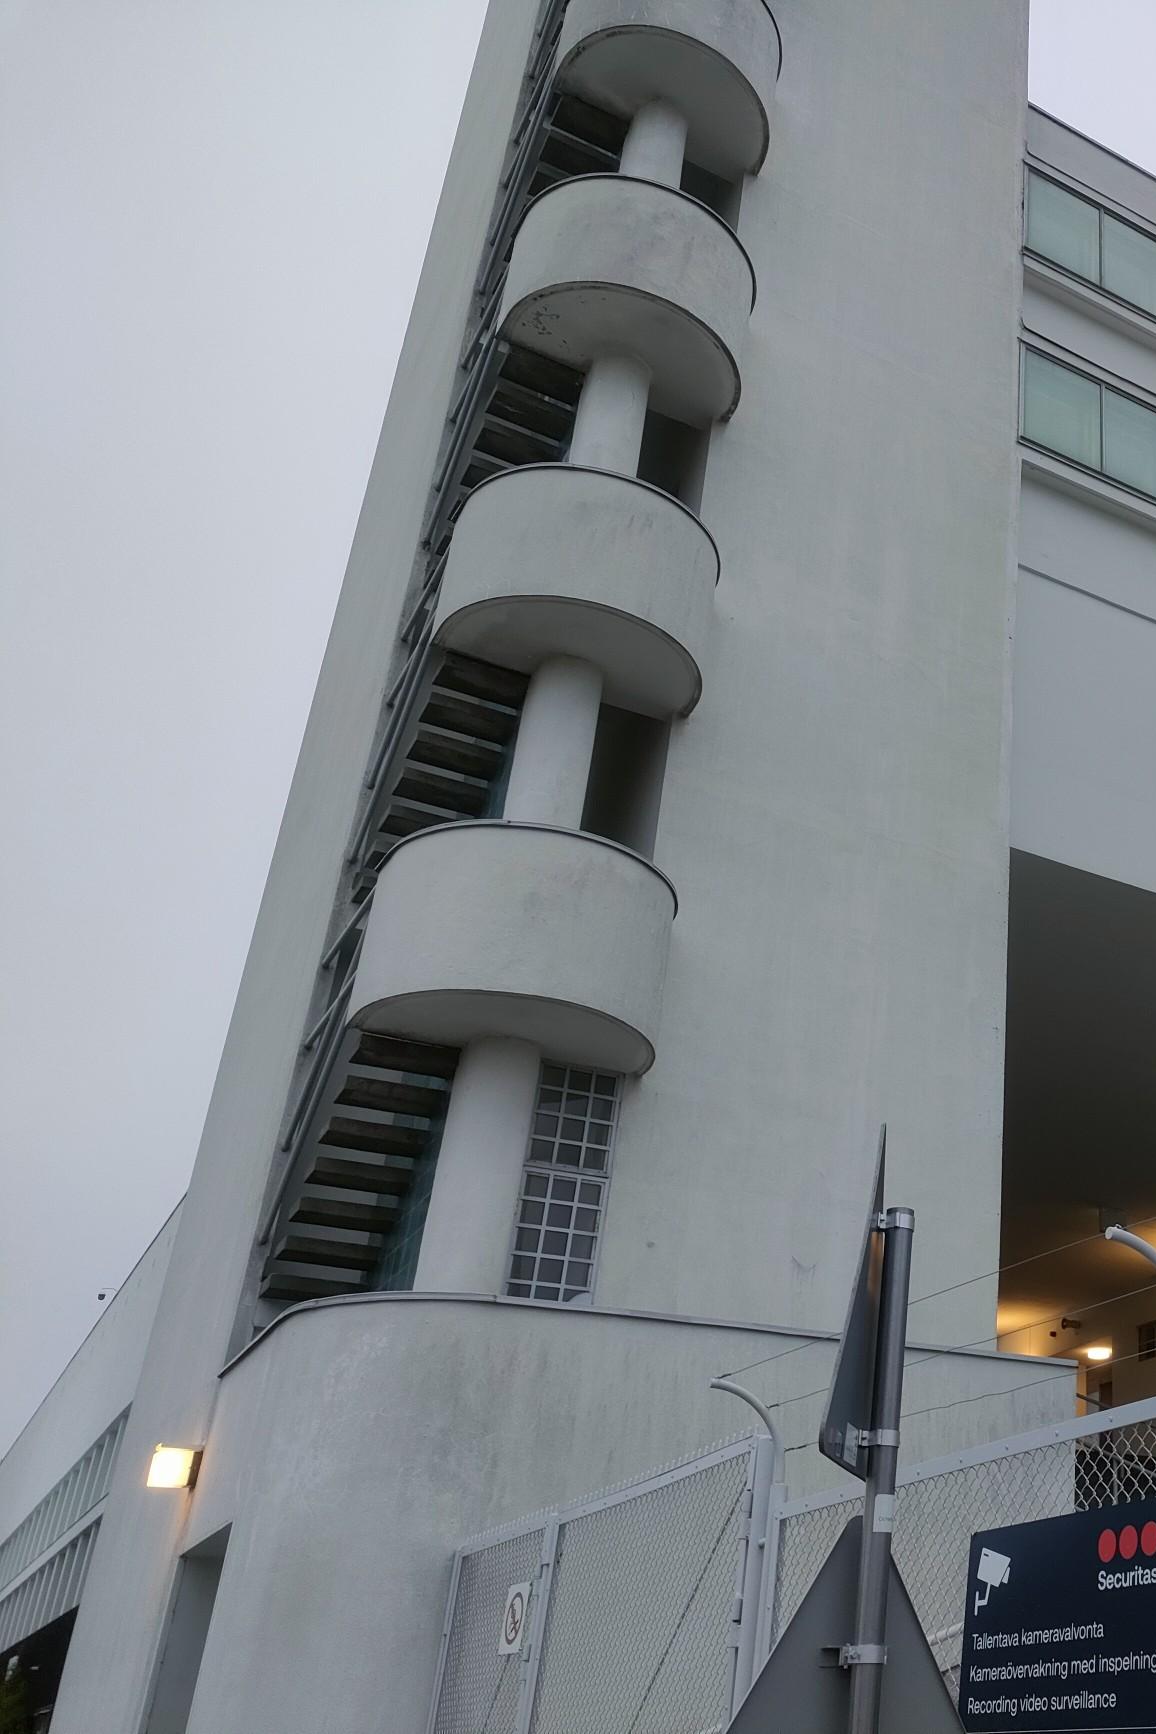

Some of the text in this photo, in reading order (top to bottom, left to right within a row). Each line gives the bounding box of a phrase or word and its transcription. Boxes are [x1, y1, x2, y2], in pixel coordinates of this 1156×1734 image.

[972, 1622, 1104, 1650] Tallentava kameravalvonta
[970, 1659, 1068, 1681] Kameraövervakning
[1071, 1655, 1095, 1674] med
[968, 1691, 1116, 1716] Recording video surveillance
